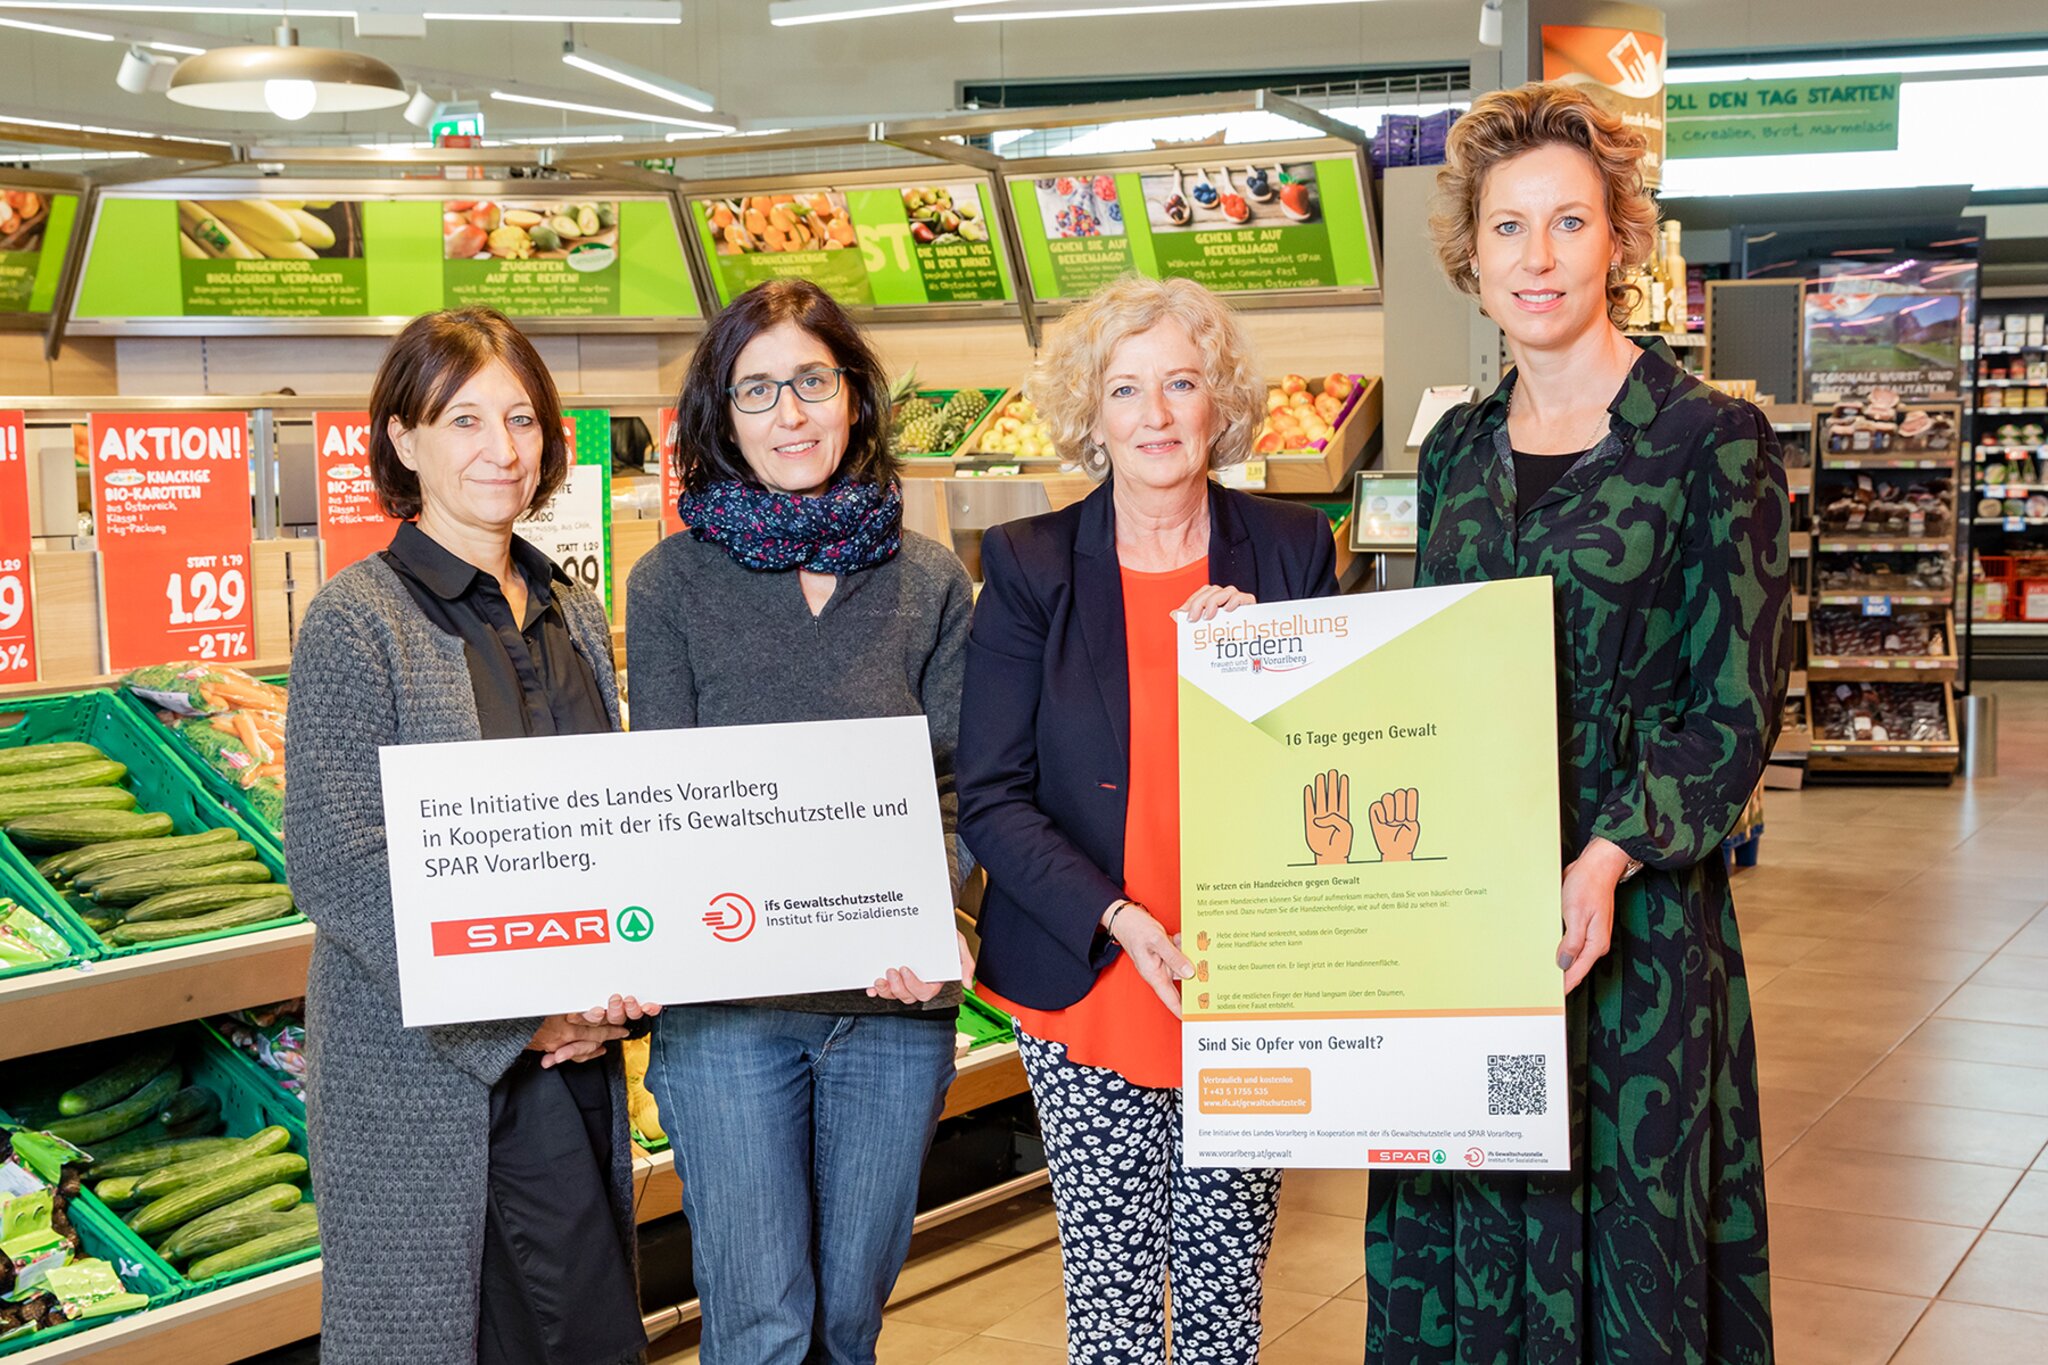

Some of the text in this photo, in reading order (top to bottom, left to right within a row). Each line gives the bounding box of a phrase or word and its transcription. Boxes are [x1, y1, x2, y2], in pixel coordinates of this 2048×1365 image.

[1666, 84, 1895, 111] OLL DEN TAG STARTEN
[1237, 231, 1254, 241] SIE
[1260, 229, 1283, 241] AUF
[99, 425, 242, 461] AKTION!
[147, 469, 211, 484] KNACKIGE
[105, 486, 201, 502] BIO-KAROTTEN
[557, 543, 578, 553] STATT
[186, 556, 217, 569] STATT
[166, 569, 245, 625] 1.29
[1194, 613, 1349, 650] gleichstellung
[188, 631, 248, 659] -27%
[1215, 635, 1303, 659] fördern
[1263, 654, 1307, 667] Vorarlberg
[1285, 722, 1437, 747] 16 Tage gegen Gewalt
[420, 779, 778, 818] Eine Initiative des Landes Vorarlberg
[422, 798, 908, 848] in Kooperation mit der ifs Gewaltschutzstelle und
[425, 848, 596, 878] SPAR Vorarlberg.
[1196, 876, 1360, 892] Wir setzen ein Handzeichen gegen Gewalt
[764, 890, 904, 912] ifs Gewaltschutzstelle
[766, 904, 919, 928] Institut für Sozialdienste
[467, 917, 605, 949] SPAR
[1198, 1035, 1384, 1054] Sind Sie Opfer von Gewalt?
[1203, 1075, 1293, 1085] Vertraulich und kostenlos
[1199, 1129, 1211, 1137] Eine
[1212, 1129, 1239, 1137] Initiative
[1241, 1129, 1252, 1137] des
[1253, 1129, 1274, 1137] Landes
[1275, 1129, 1308, 1139] Vorarlberg
[1317, 1129, 1355, 1139] Kooperation
[1453, 1130, 1466, 1138] und
[1468, 1130, 1485, 1138] SPAR
[1199, 1149, 1292, 1160] www.vorarlberg.at/gewalt
[1379, 1151, 1428, 1161] SPAR
